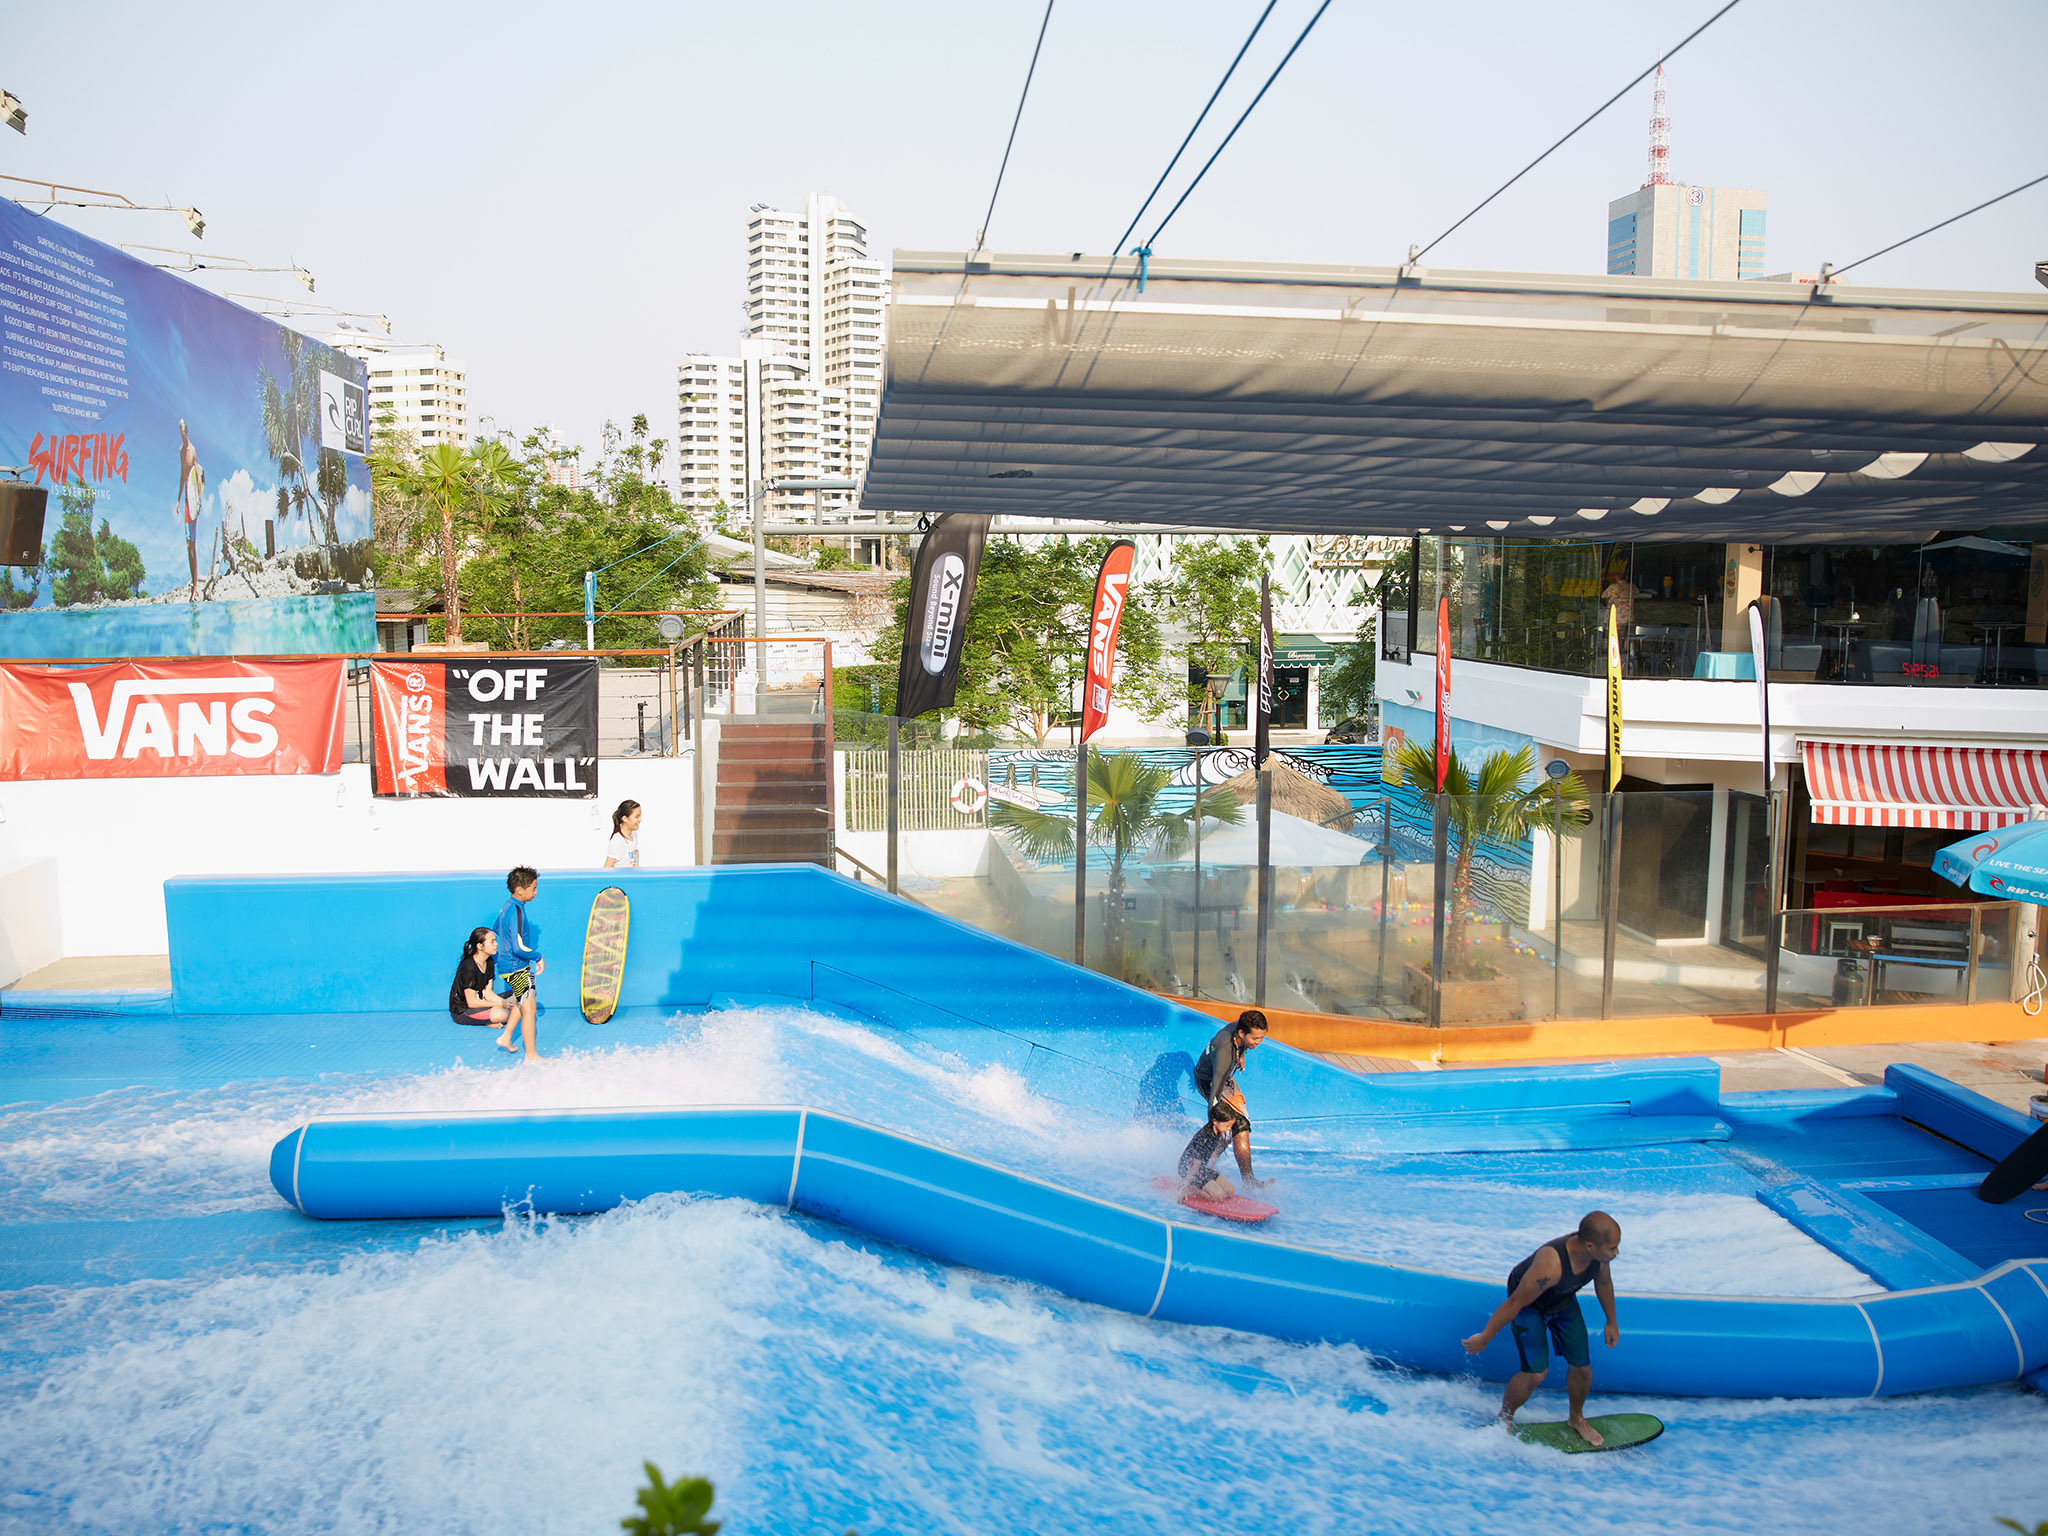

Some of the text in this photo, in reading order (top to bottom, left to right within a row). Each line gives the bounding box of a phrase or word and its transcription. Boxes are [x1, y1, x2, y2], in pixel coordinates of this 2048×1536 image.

[1691, 190, 1701, 203] 3
[345, 396, 358, 417] RIP
[346, 416, 363, 438] CURL
[28, 432, 129, 486] SURFING
[51, 485, 111, 500] IS EVERYTHING
[925, 574, 941, 647] Sound Beyond Size
[933, 569, 962, 658] X-mini
[1093, 573, 1128, 679] VANS
[67, 676, 279, 760] VANS
[468, 713, 545, 746] THE
[1989, 859, 2011, 869] LIVE
[2013, 863, 2032, 873] THE
[2006, 886, 2030, 895] RIP
